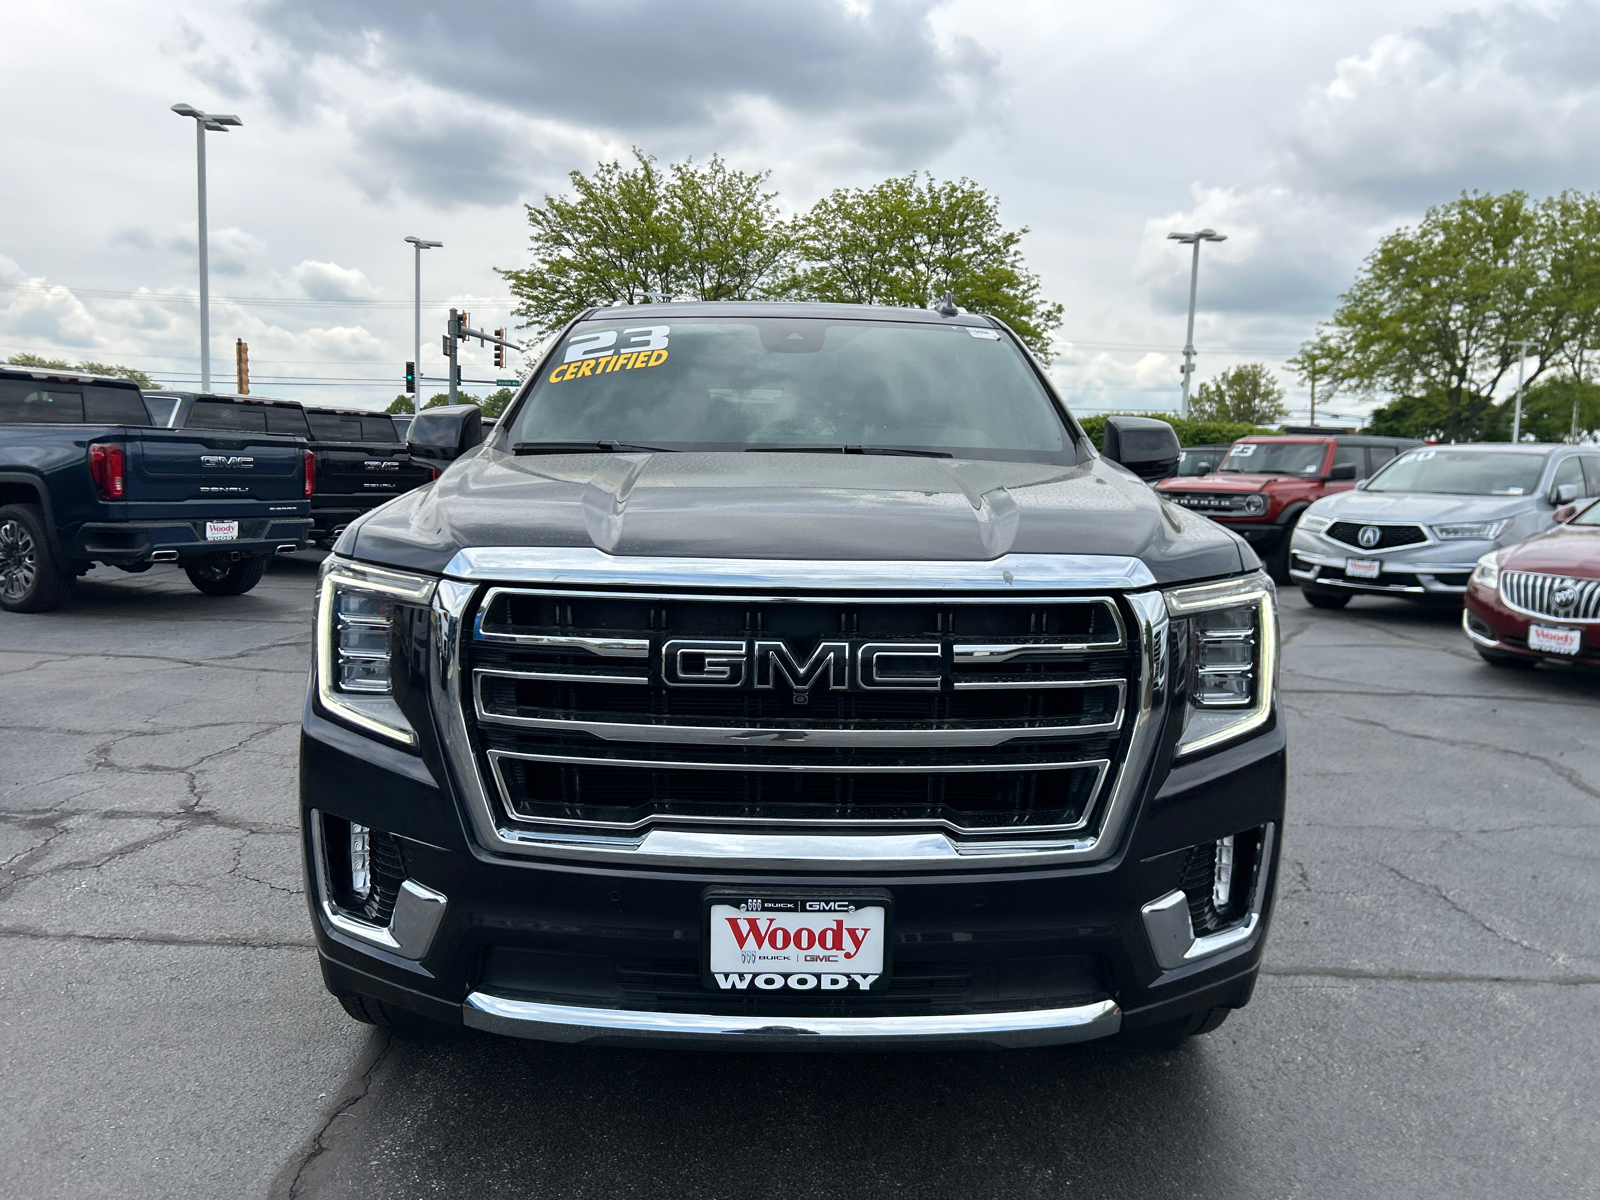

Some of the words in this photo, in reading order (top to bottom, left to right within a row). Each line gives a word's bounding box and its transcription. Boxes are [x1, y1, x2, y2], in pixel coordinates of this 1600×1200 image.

[563, 325, 671, 363] 23
[549, 349, 669, 383] CERTIFIED
[1229, 443, 1257, 457] 23
[200, 455, 254, 469] GMC
[364, 461, 400, 470] GMC
[208, 524, 236, 534] Woody
[1535, 629, 1576, 646] Woody
[661, 638, 943, 691] GMC
[805, 901, 849, 911] GMC
[724, 917, 871, 960] Woody
[804, 954, 839, 963] GMC
[713, 973, 880, 991] WOODY
